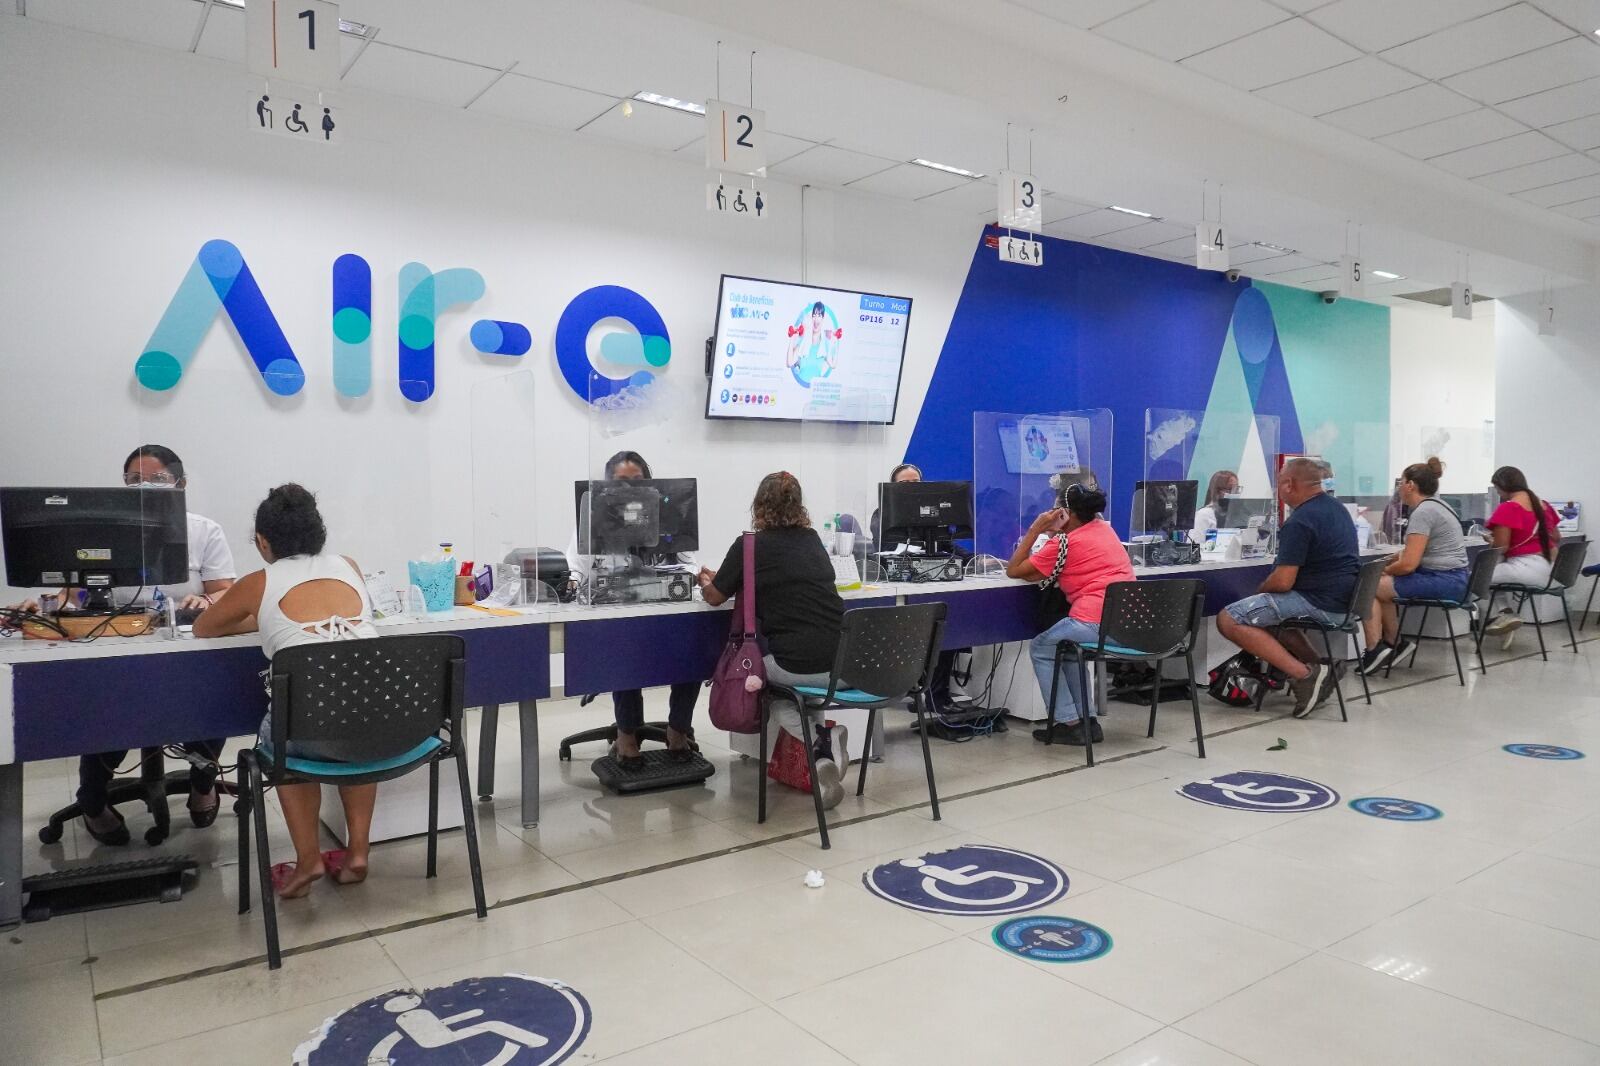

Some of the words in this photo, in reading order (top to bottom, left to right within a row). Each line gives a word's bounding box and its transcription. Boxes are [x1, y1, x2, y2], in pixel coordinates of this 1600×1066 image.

[298, 9, 315, 50] 1
[736, 114, 753, 148] 2
[1021, 180, 1034, 208] 3
[1214, 228, 1224, 251] 4
[1354, 262, 1361, 282] 5
[863, 298, 885, 309] Turno
[890, 303, 907, 312] Mod
[1464, 288, 1470, 306] 6
[890, 318, 900, 326] 12
